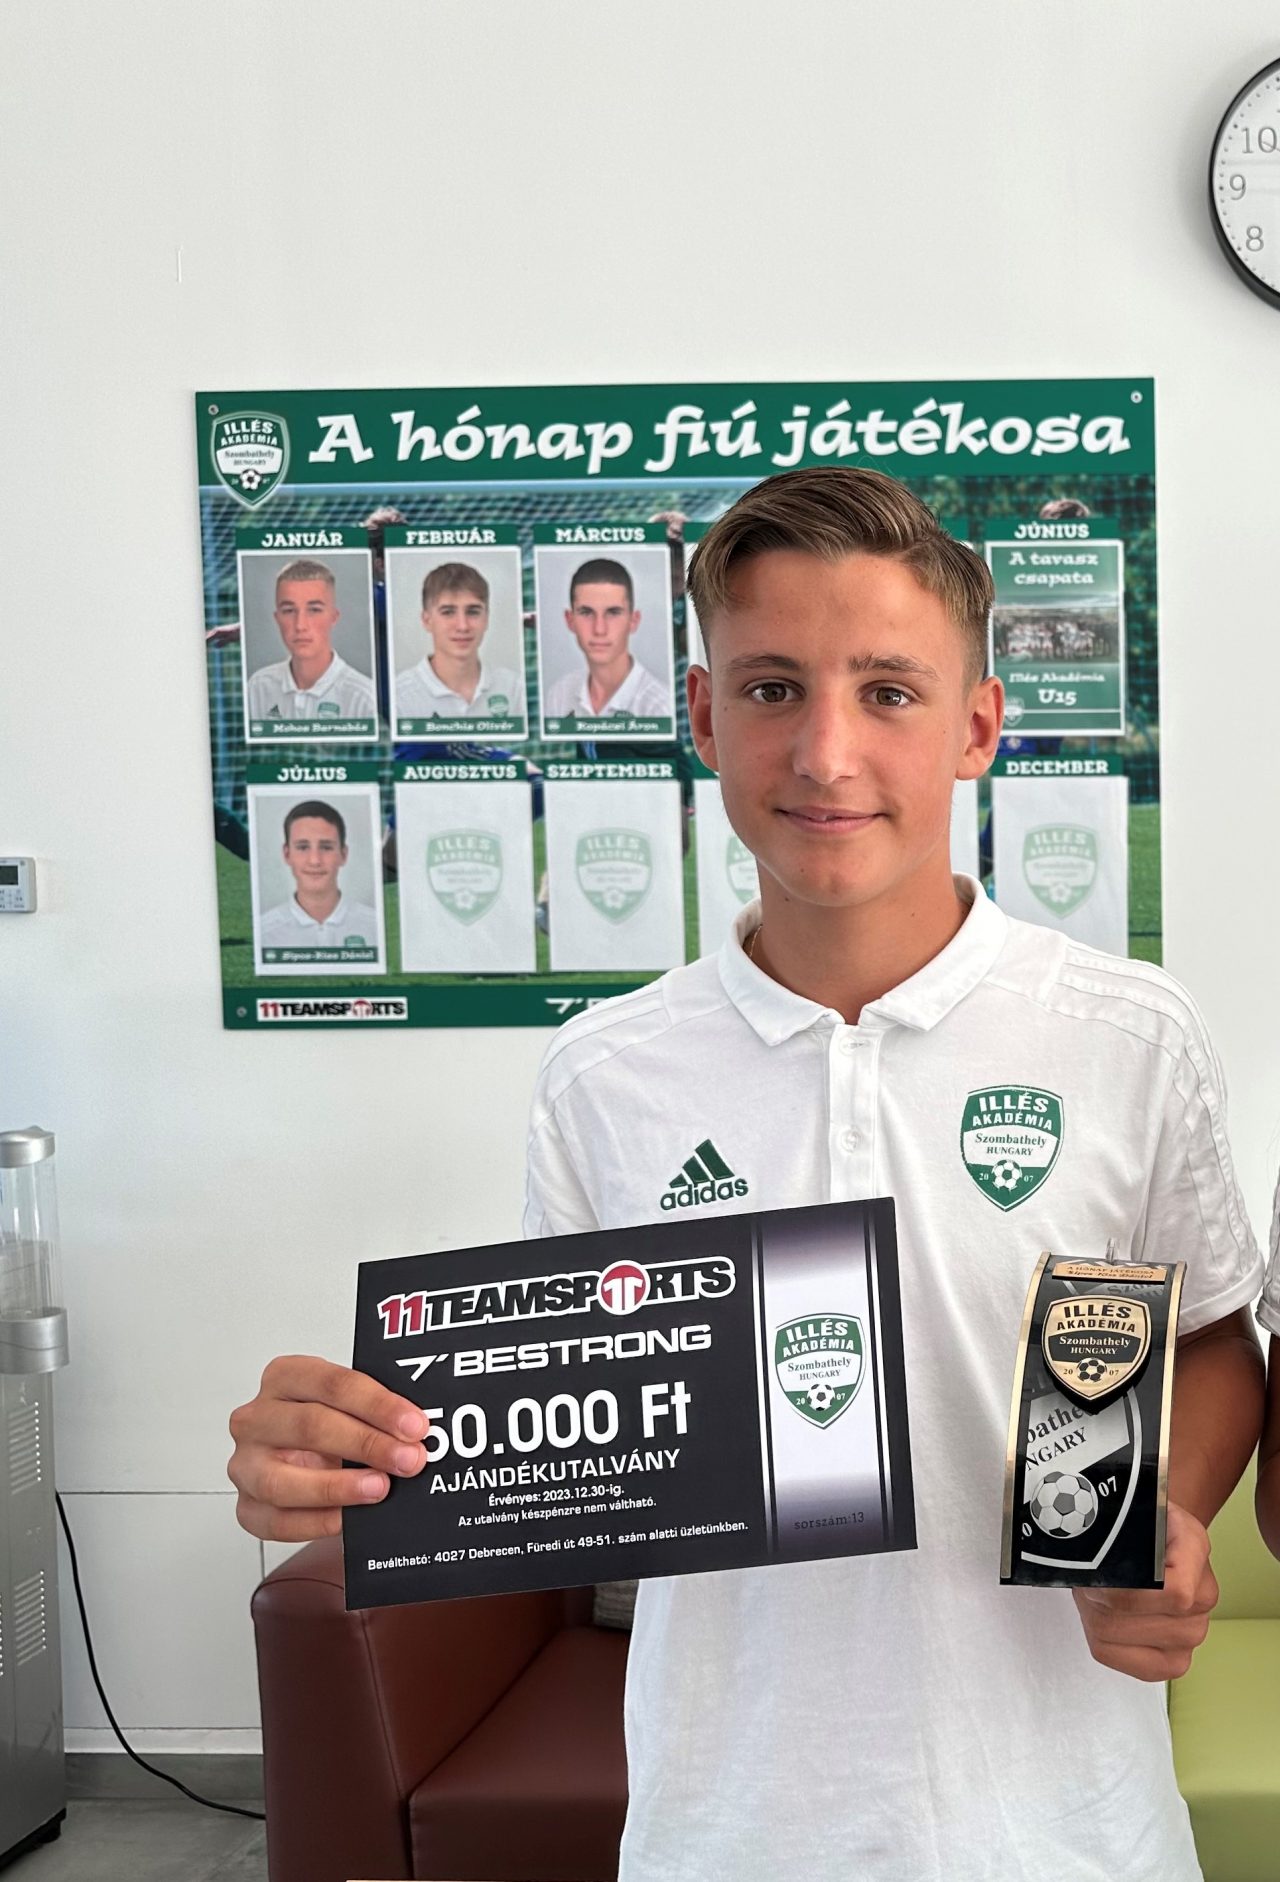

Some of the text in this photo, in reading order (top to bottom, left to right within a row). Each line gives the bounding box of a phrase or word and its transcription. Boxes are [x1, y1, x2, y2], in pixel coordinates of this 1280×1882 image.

[1241, 127, 1277, 153] 10
[1229, 174, 1247, 200] 9
[1245, 225, 1264, 251] 8
[308, 398, 1131, 475] A hónap fiú játékosa
[261, 529, 344, 548] JANUÁR
[406, 527, 496, 546] FEBRUÁR
[556, 526, 645, 544] MÁRCIUS
[1014, 521, 1090, 539] JÚNIUS
[1009, 552, 1099, 566] A tavasz
[1014, 572, 1094, 588] csapata
[1038, 688, 1077, 706] U15
[277, 764, 348, 782] JÚLIUS
[404, 764, 517, 780] AUGUSZTUS
[546, 763, 673, 779] SZEPTEMBER
[1005, 760, 1109, 775] DECEMBER
[979, 1092, 1049, 1113] ILLÉS
[972, 1112, 1053, 1131] AKADÉMIA
[975, 1132, 1047, 1148] Szombathely
[986, 1146, 1033, 1157] HUNGARY
[660, 1176, 749, 1211] adidas
[1063, 1302, 1132, 1319] ILLÉS
[786, 1320, 848, 1341] ILLÉS
[1056, 1318, 1136, 1332] AKADÉMIA
[454, 1324, 712, 1377] BESTRONG
[782, 1338, 855, 1358] AKADÉMIA
[1059, 1336, 1131, 1347] Szombathely
[1070, 1347, 1118, 1355] HUNGARY
[787, 1356, 852, 1373] Szombathely
[799, 1369, 841, 1381] HUNGARY
[422, 1381, 691, 1463] 50.000 Ft
[429, 1448, 681, 1494] AJÁNDÉKUTALVÁNY
[488, 1484, 625, 1507] Érvényes: 2023.12.30-ig.
[1098, 1476, 1117, 1497] 07
[458, 1497, 657, 1527] Az utalvány készpénzre nem váltható.
[794, 1511, 865, 1530] sorszám:13
[368, 1521, 749, 1570] Beváltható: 4027 Debrecen, Füredi út 49-51. szám alatti üzletünkben.
